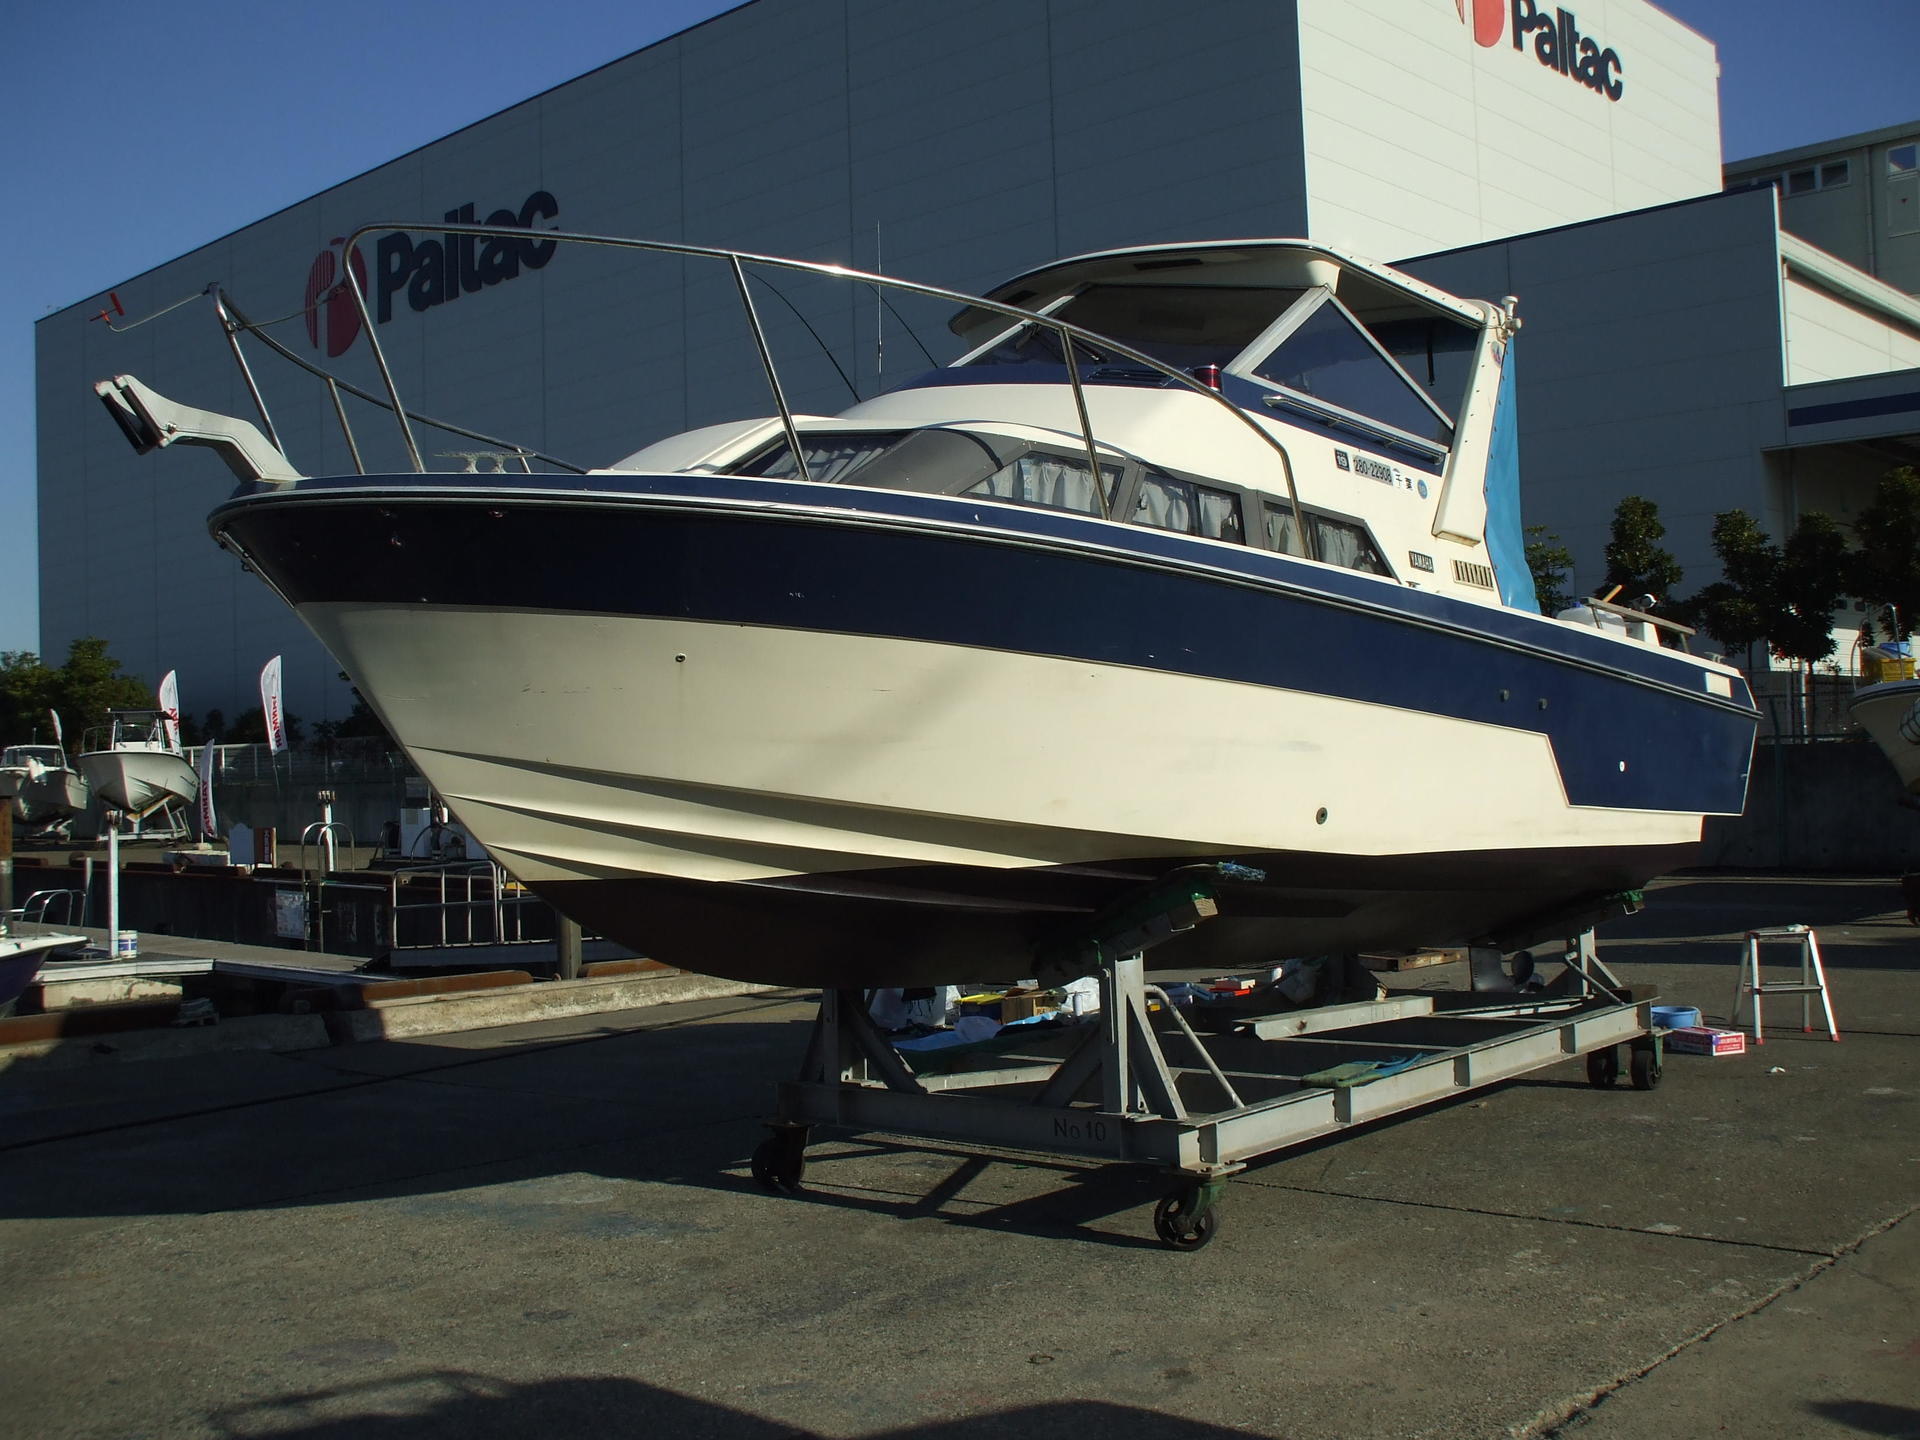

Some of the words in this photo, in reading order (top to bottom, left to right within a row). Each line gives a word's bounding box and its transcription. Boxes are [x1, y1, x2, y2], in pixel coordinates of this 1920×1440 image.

[1510, 0, 1623, 102] Paltac
[377, 190, 559, 324] Paltac
[1410, 552, 1433, 570] YAMAHA
[1085, 1120, 1106, 1142] 10
